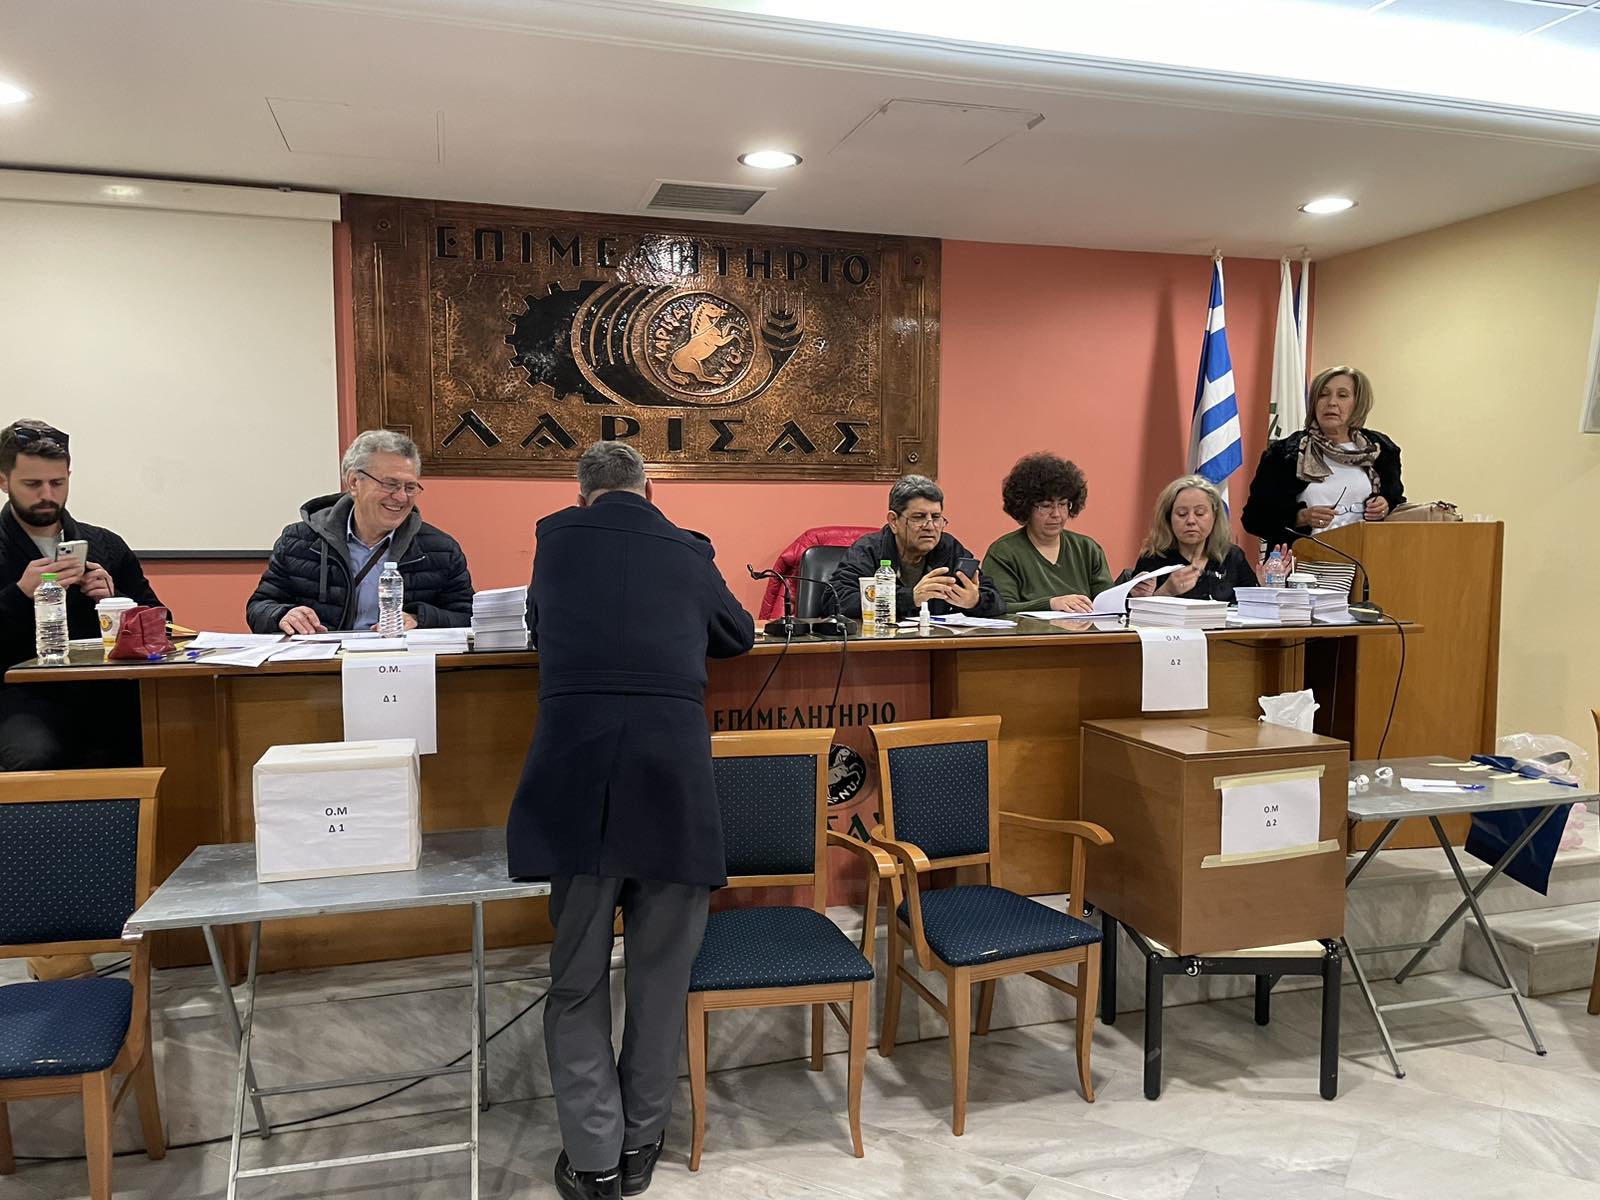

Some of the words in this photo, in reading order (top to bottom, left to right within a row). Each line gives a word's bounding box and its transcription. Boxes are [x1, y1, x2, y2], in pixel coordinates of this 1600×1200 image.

[436, 226, 871, 285] ΕΠΙΜΕΛΗΤΗΡΙΟ
[441, 409, 872, 454] ΛΑΡΙΣΑΣ
[378, 665, 401, 673] Ο.Μ.
[713, 702, 896, 732] ΕΠΙΜΕΛΗΤΗΡΙΟ
[325, 806, 348, 816] Ο.Μ
[1263, 804, 1279, 813] Ο.Μ
